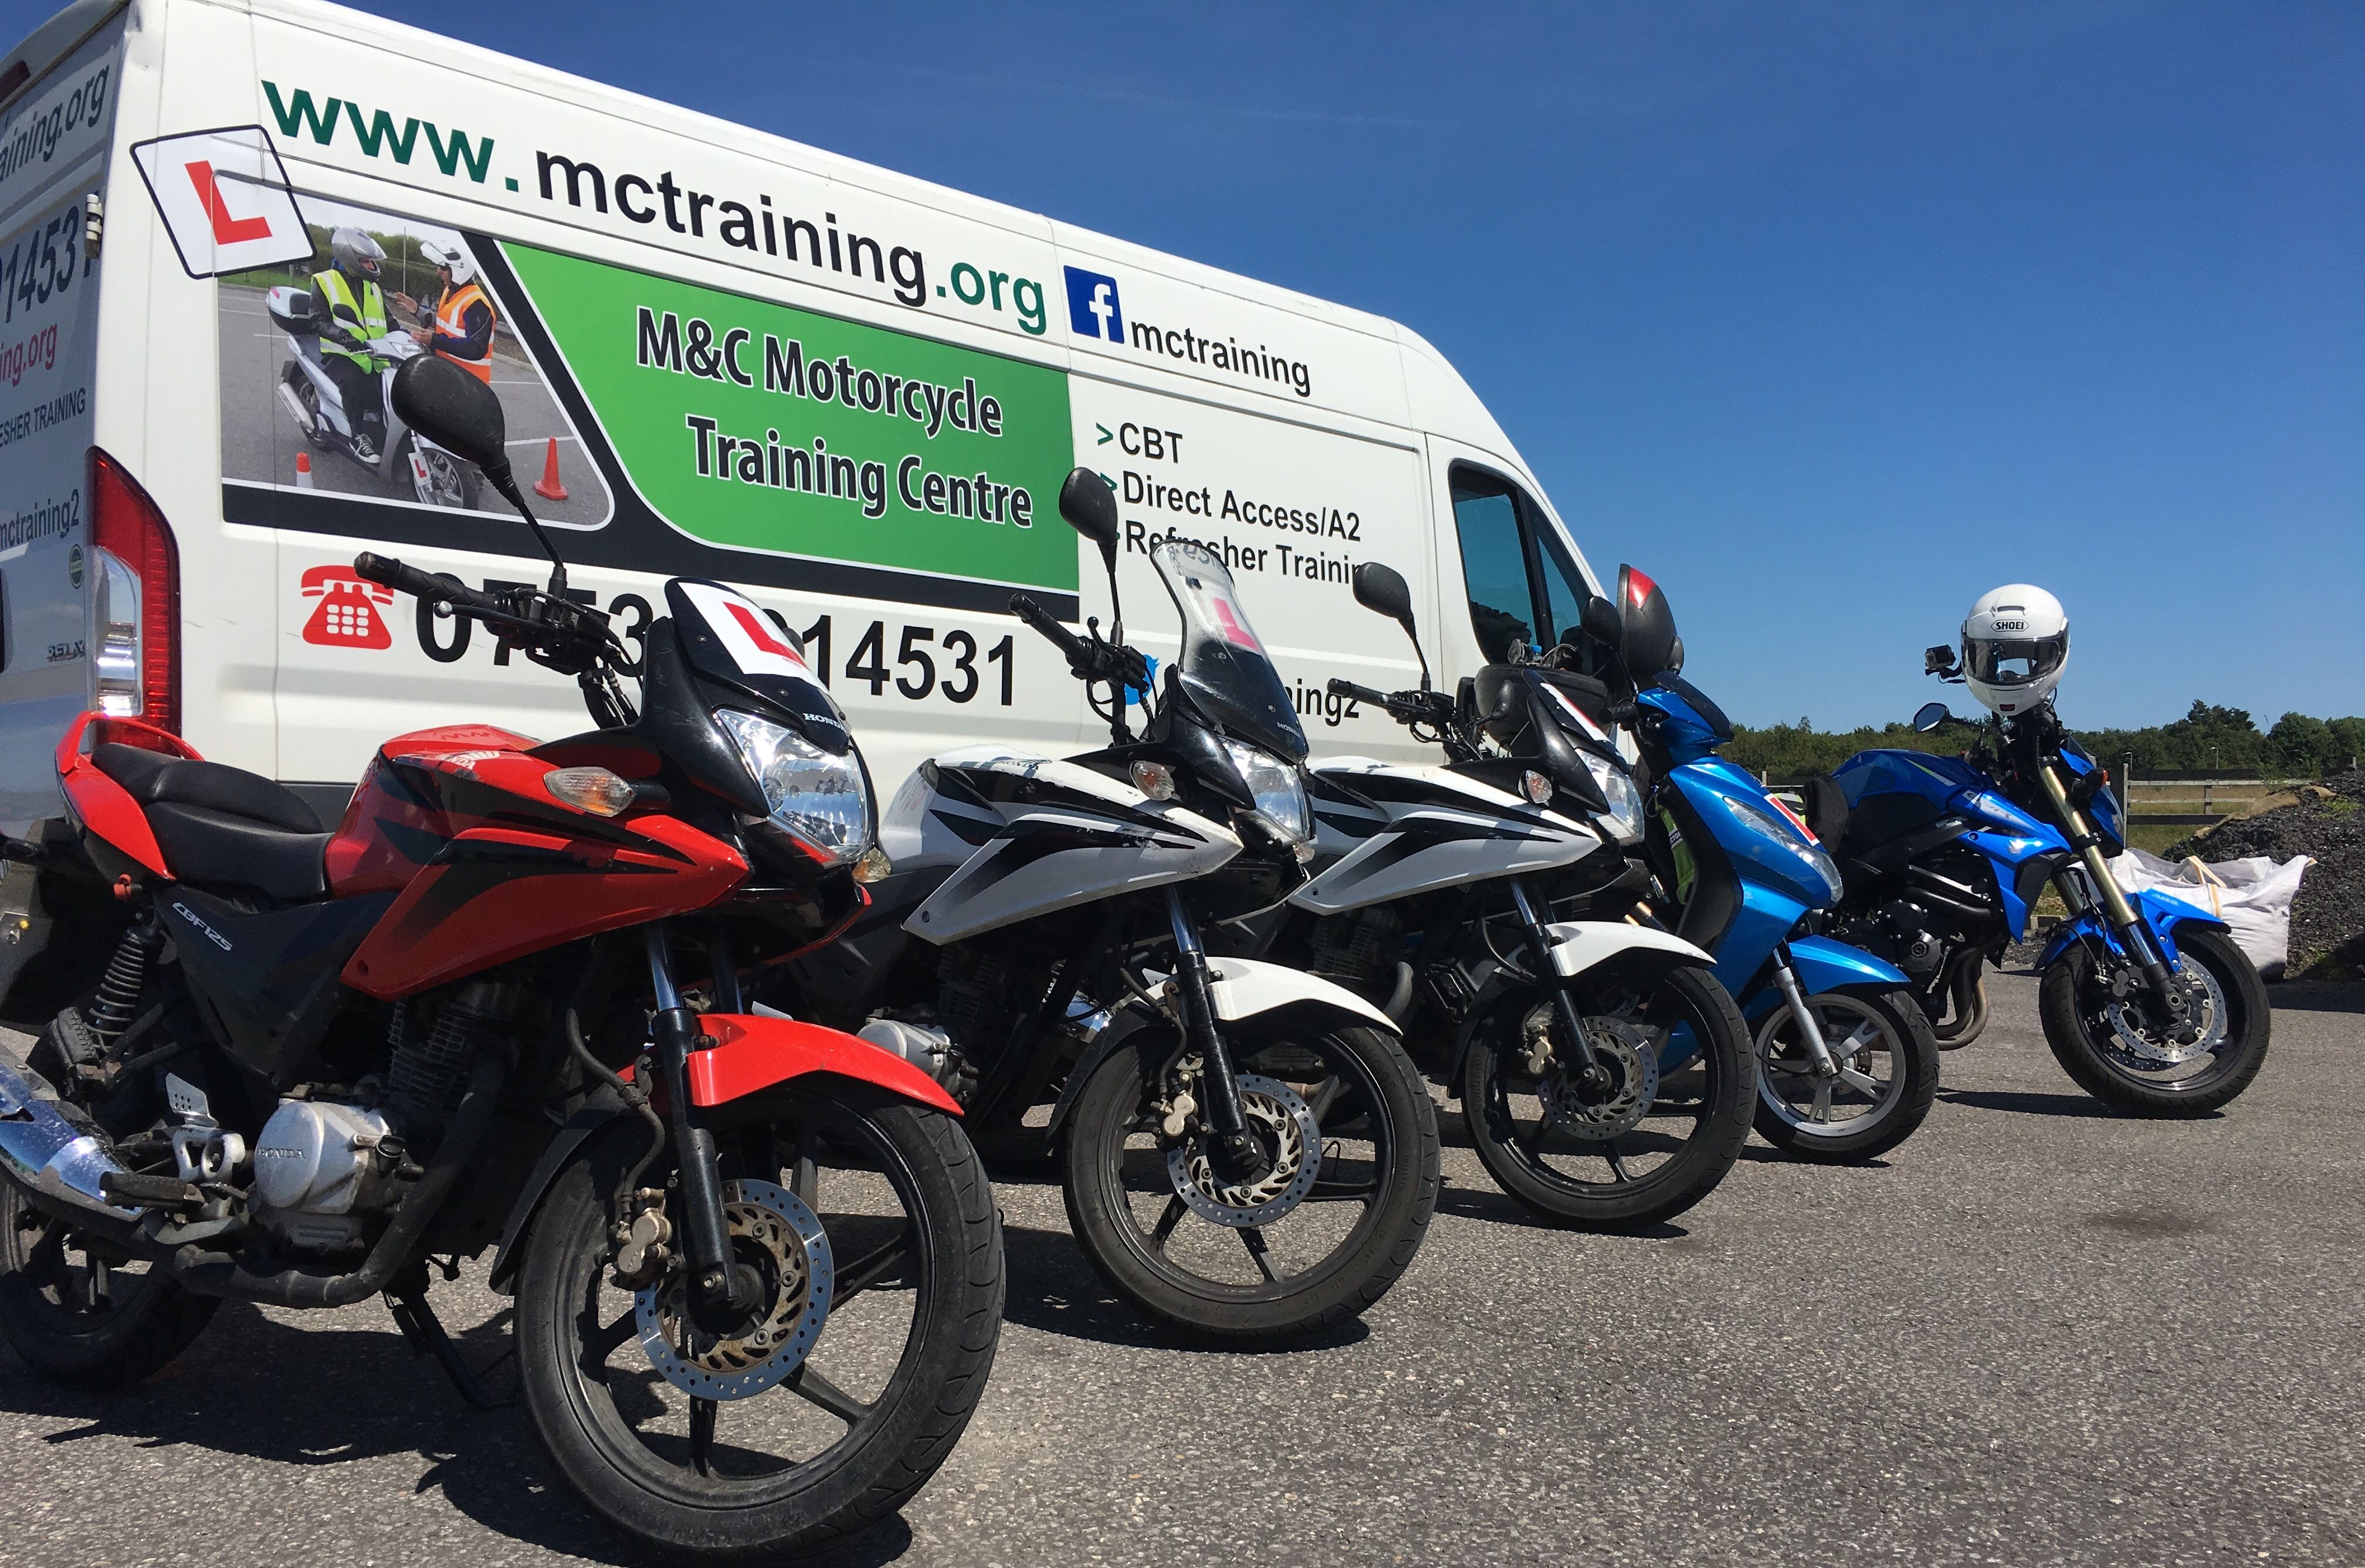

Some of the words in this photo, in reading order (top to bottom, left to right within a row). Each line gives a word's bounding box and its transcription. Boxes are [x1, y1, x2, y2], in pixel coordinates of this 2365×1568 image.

[184, 160, 272, 245] L
[636, 305, 754, 388] M&C
[764, 334, 1002, 439] Motorcycle
[1131, 321, 1311, 397] mctraining
[33, 387, 86, 432] TRAINING
[1119, 422, 1183, 463] CBT
[414, 459, 427, 478] L
[685, 413, 886, 519] Training
[897, 454, 1033, 528] Centre
[1123, 470, 1212, 517] Direct
[1221, 490, 1361, 542] Access/A2
[722, 601, 810, 670] L
[762, 608, 1013, 706] 14531
[1212, 597, 1262, 654] L
[1995, 622, 2024, 630] SHOEI
[172, 902, 233, 951] CBF125
